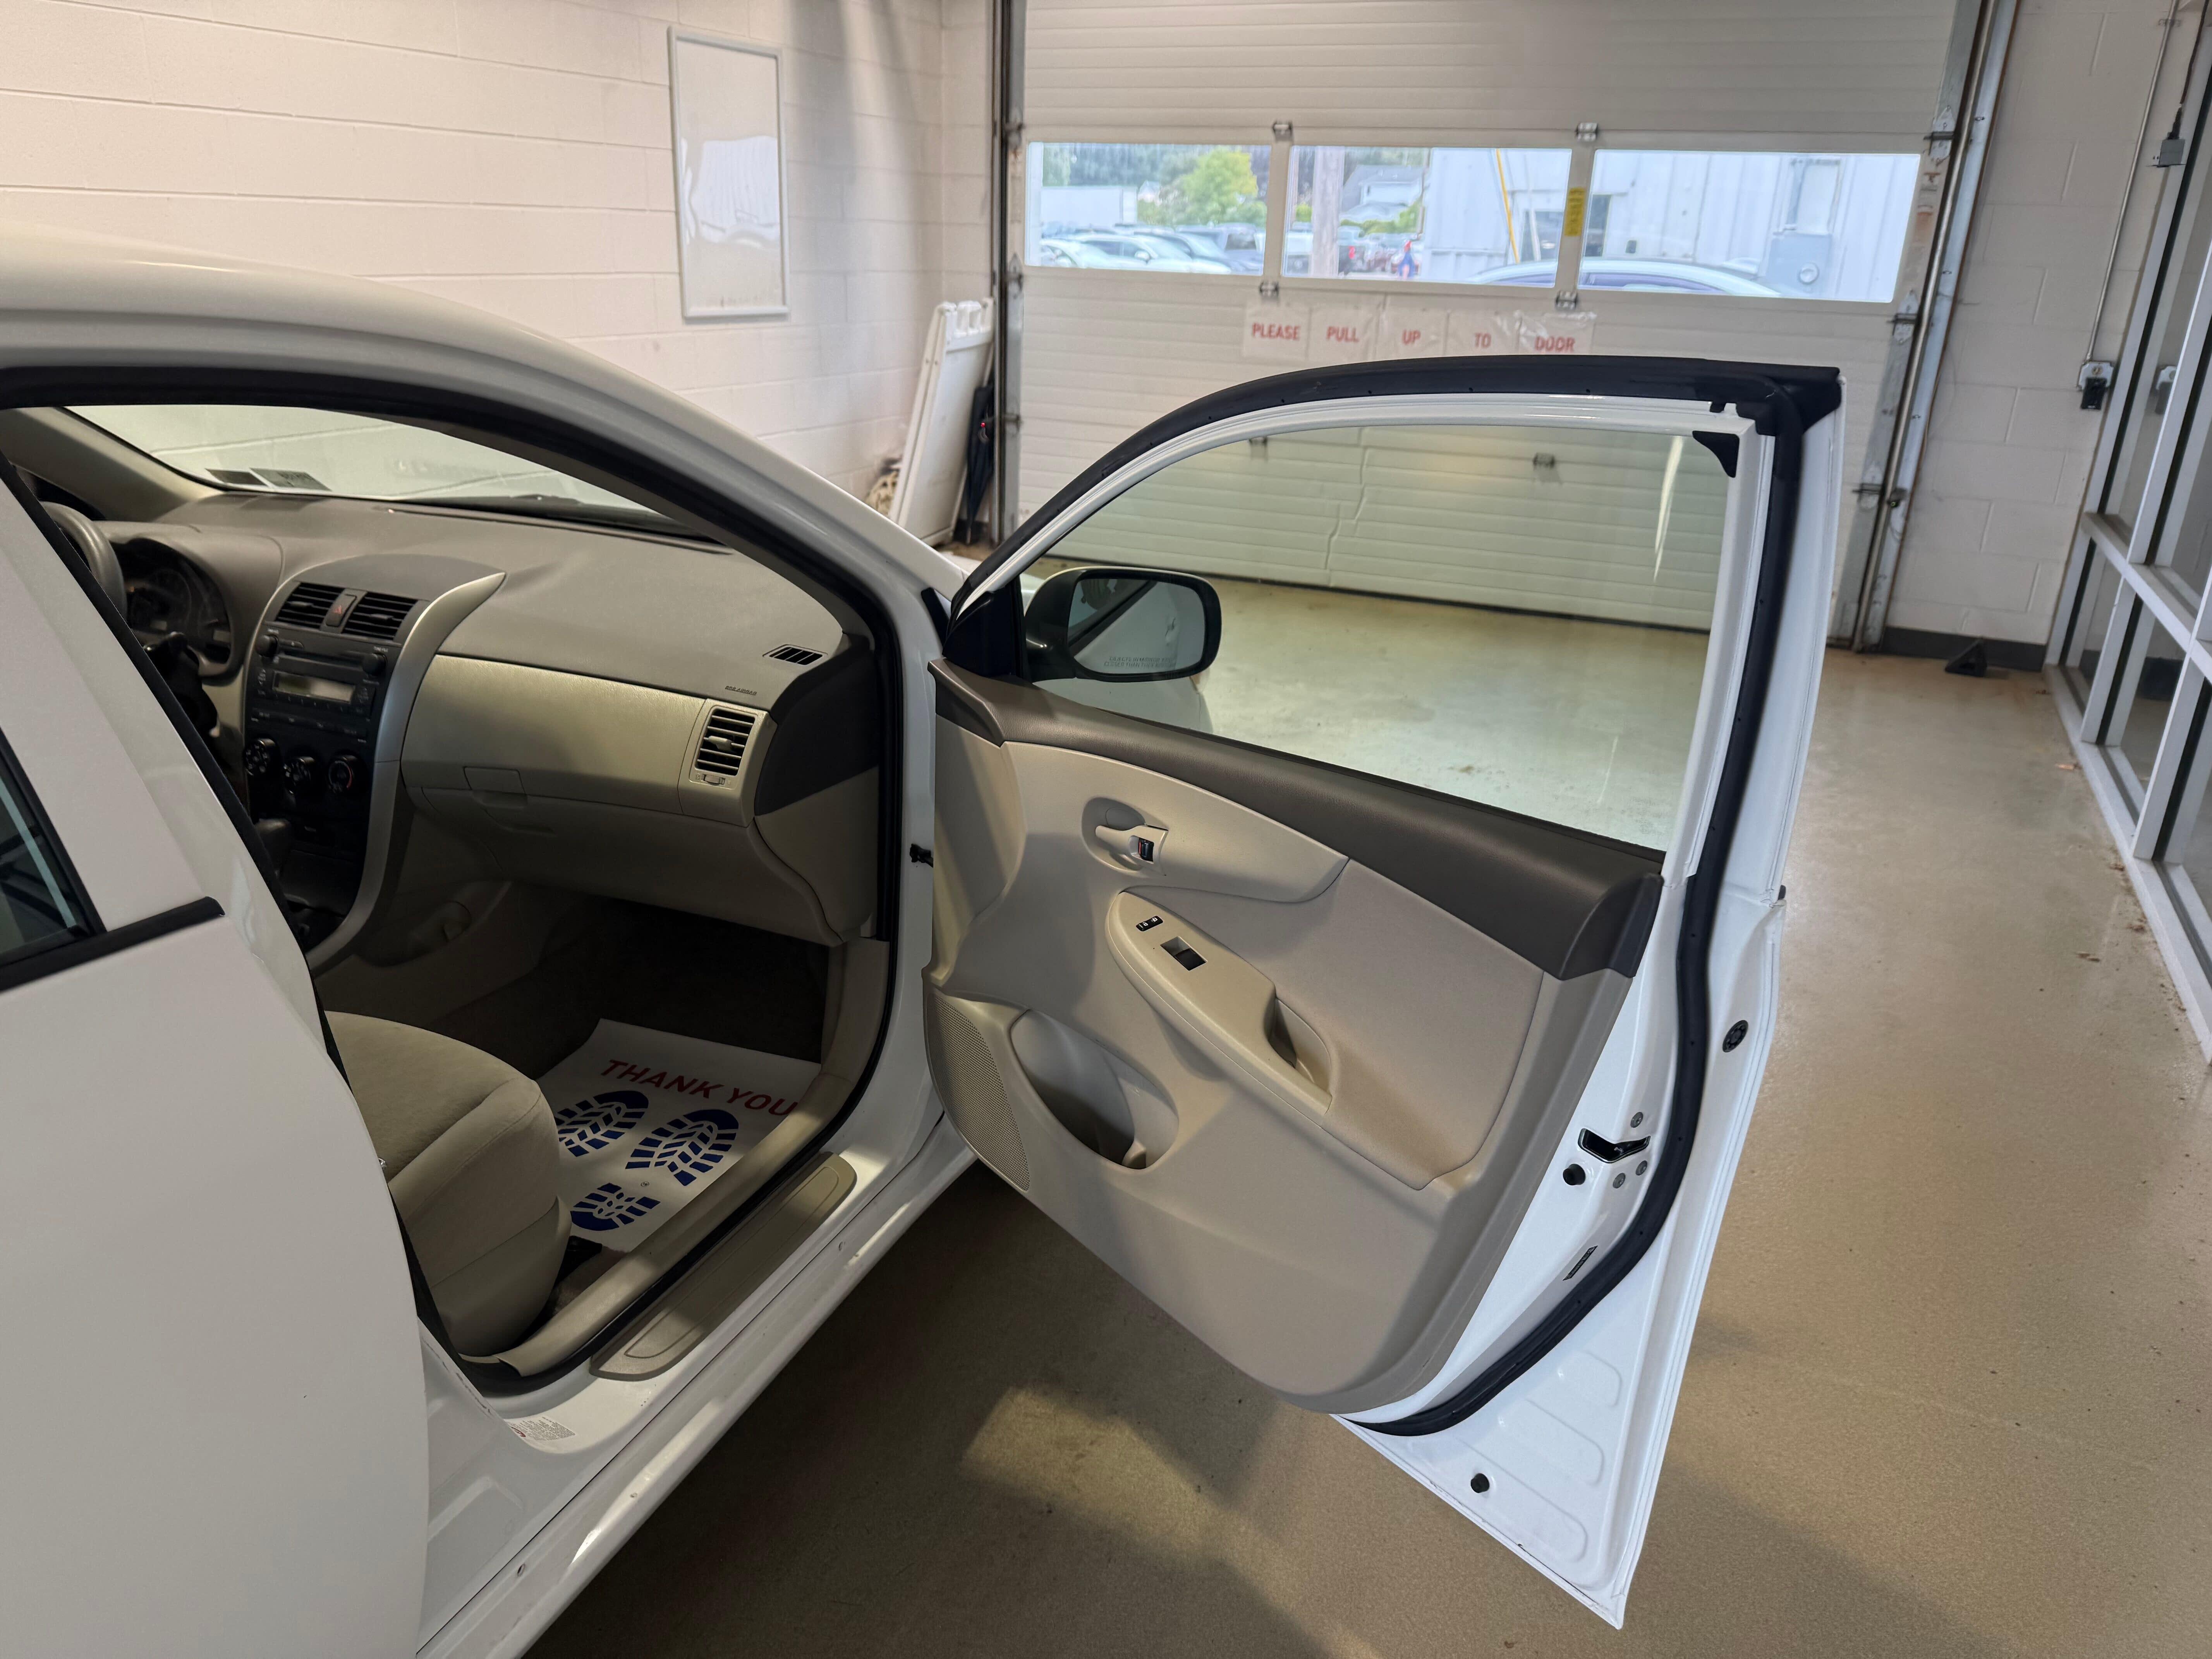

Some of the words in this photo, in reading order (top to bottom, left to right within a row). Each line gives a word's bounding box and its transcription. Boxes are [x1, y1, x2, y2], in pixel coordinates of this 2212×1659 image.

[1252, 323, 1300, 341] PLEASE
[1326, 326, 1360, 342] PULL
[1402, 329, 1421, 344] UP
[1475, 333, 1492, 348] TO
[1534, 336, 1576, 352] DOOR
[601, 1059, 724, 1099] THANK
[726, 1087, 798, 1116] YOU
